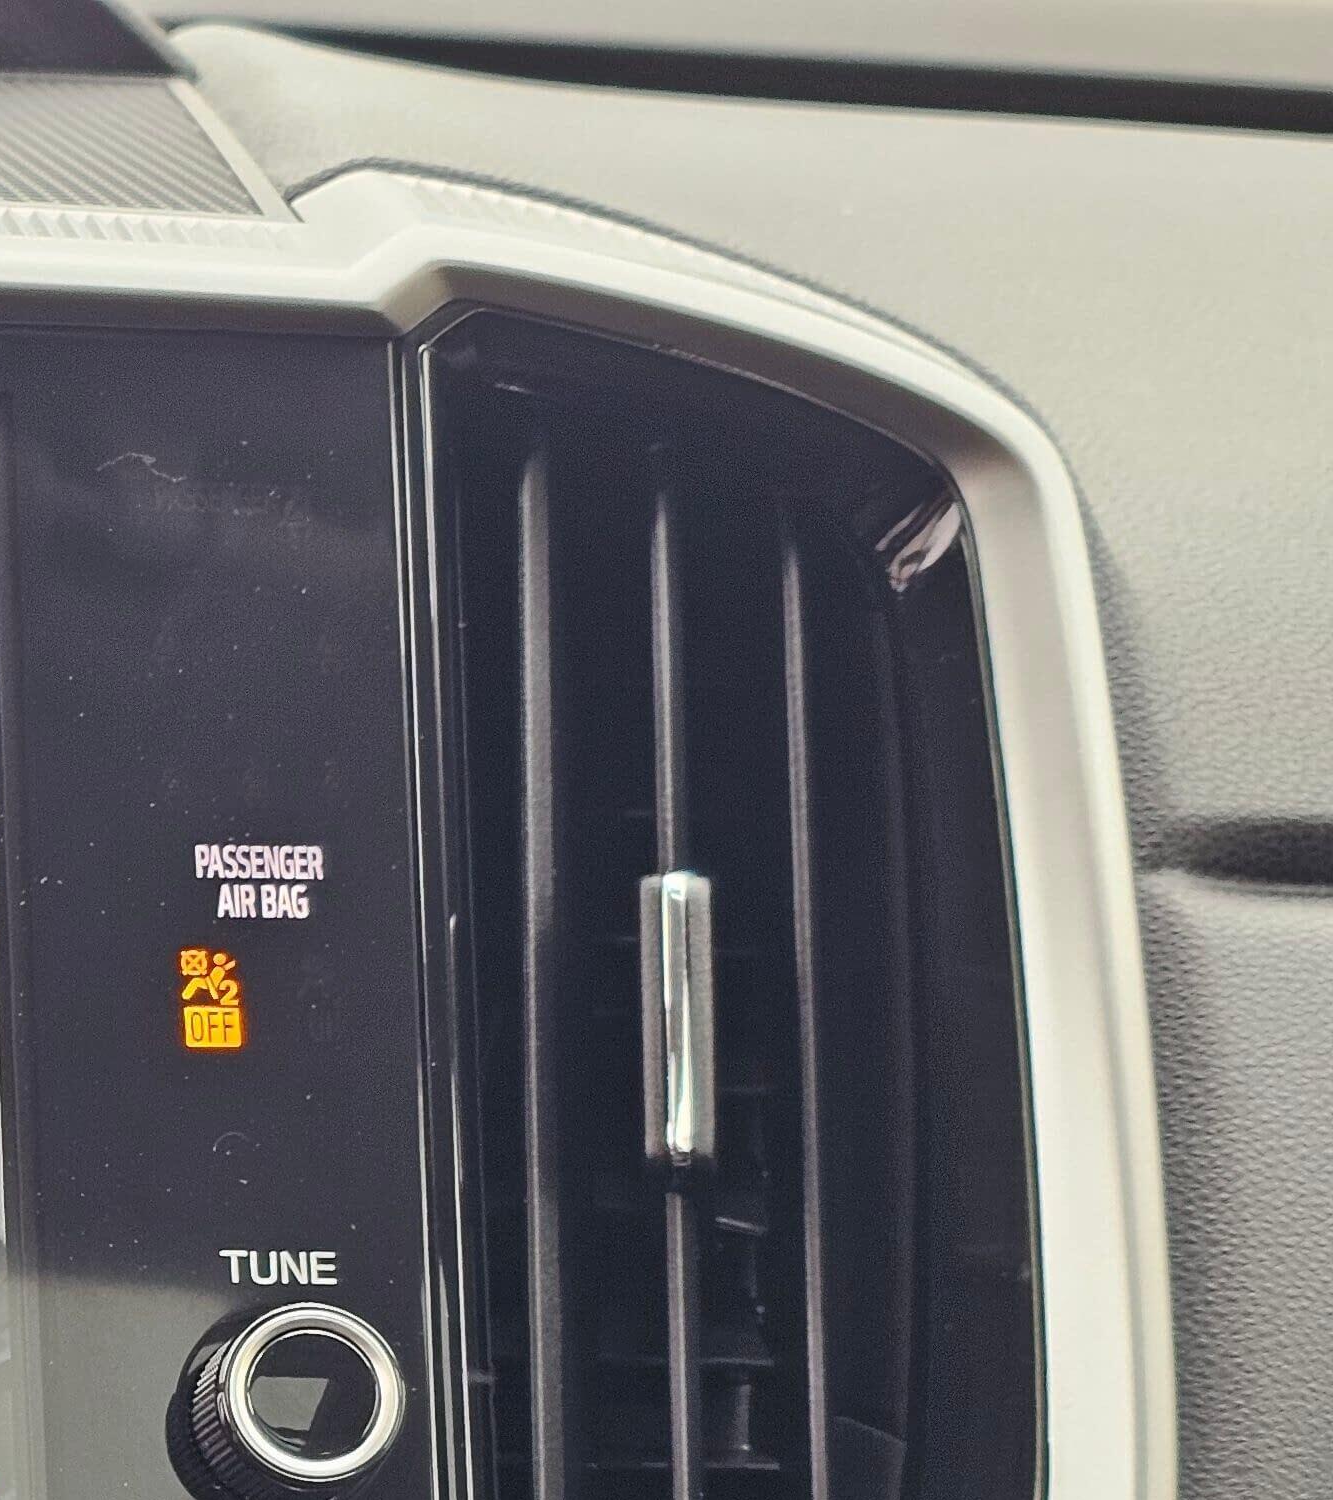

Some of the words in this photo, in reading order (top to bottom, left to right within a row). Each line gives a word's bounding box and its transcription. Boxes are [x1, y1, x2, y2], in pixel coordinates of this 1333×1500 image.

[195, 844, 324, 880] PASSENGER
[217, 884, 257, 919] AIR
[261, 885, 309, 919] BAG
[189, 1011, 234, 1042] OFF
[219, 1250, 338, 1285] TUNE
